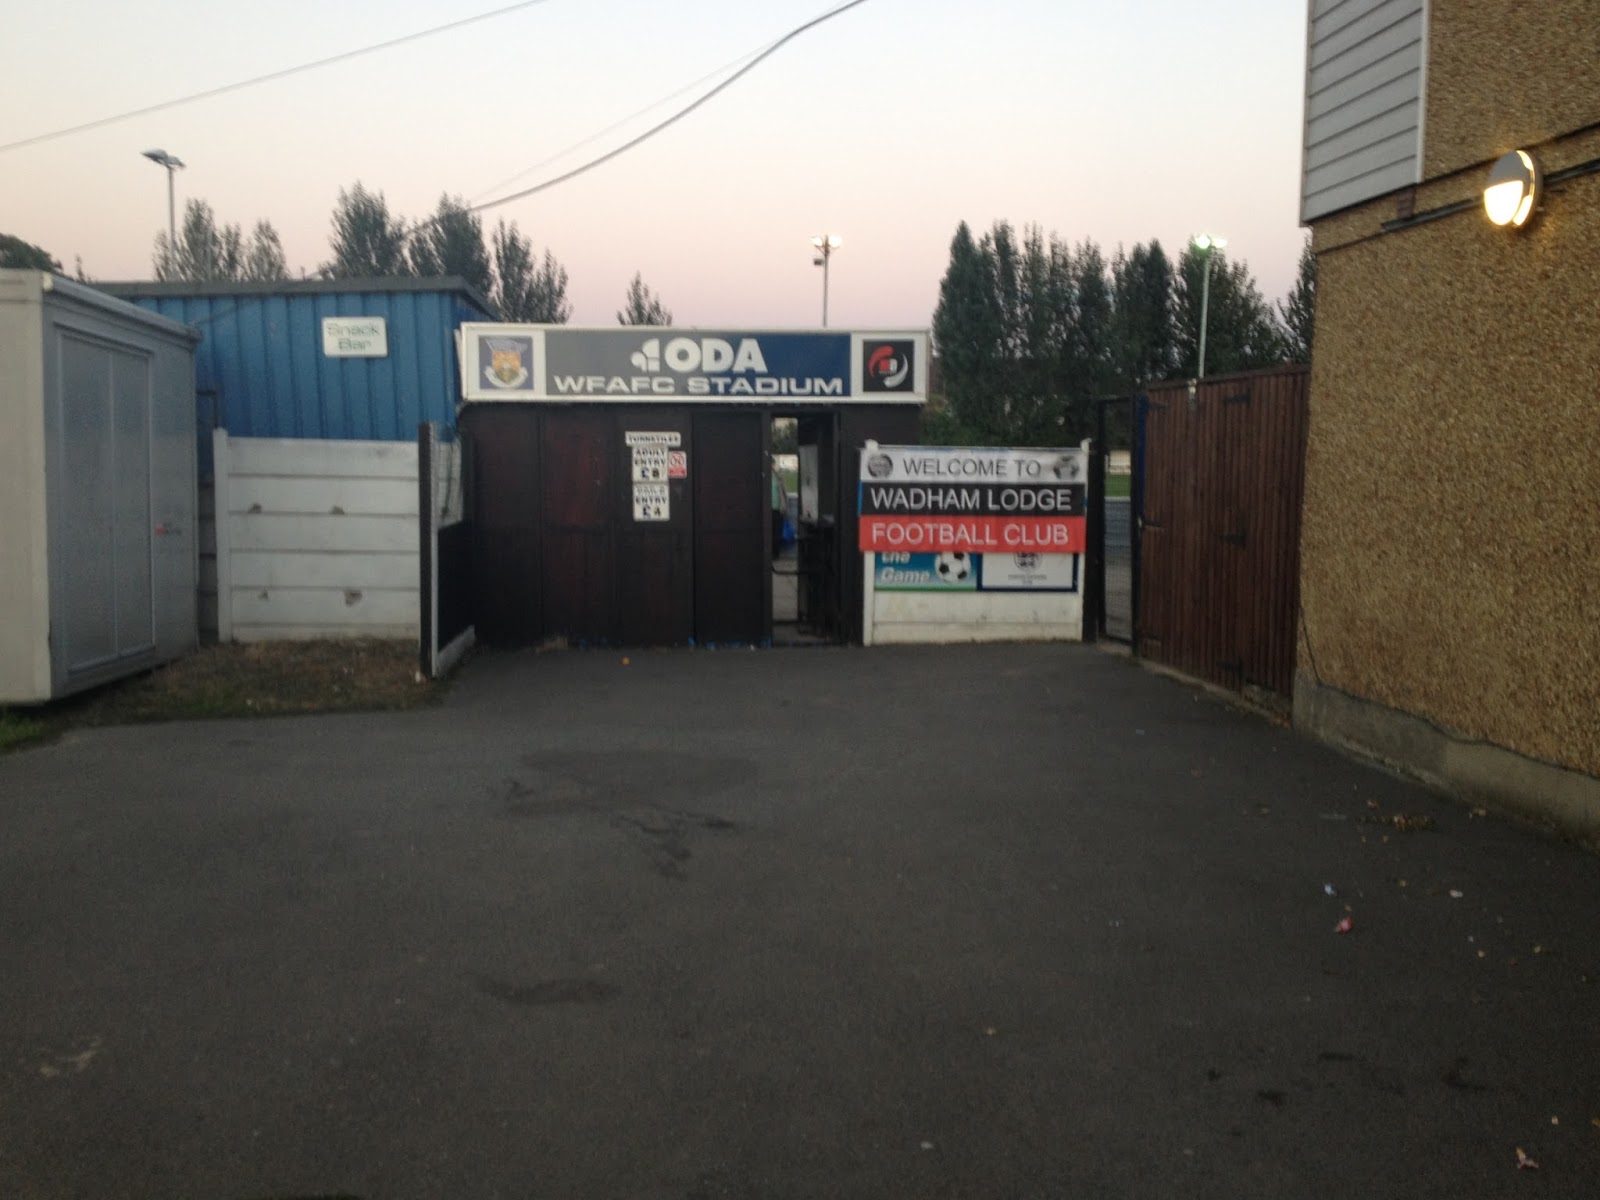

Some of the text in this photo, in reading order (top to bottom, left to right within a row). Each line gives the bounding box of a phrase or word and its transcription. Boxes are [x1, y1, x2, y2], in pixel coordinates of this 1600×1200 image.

[553, 376, 843, 394] WFAFC STADIUM
[903, 458, 1041, 477] WELCOME TO
[871, 487, 1072, 511] WADHAM LODGE
[872, 523, 1068, 545] FOOTBALL CLUB
[881, 567, 931, 583] Game
